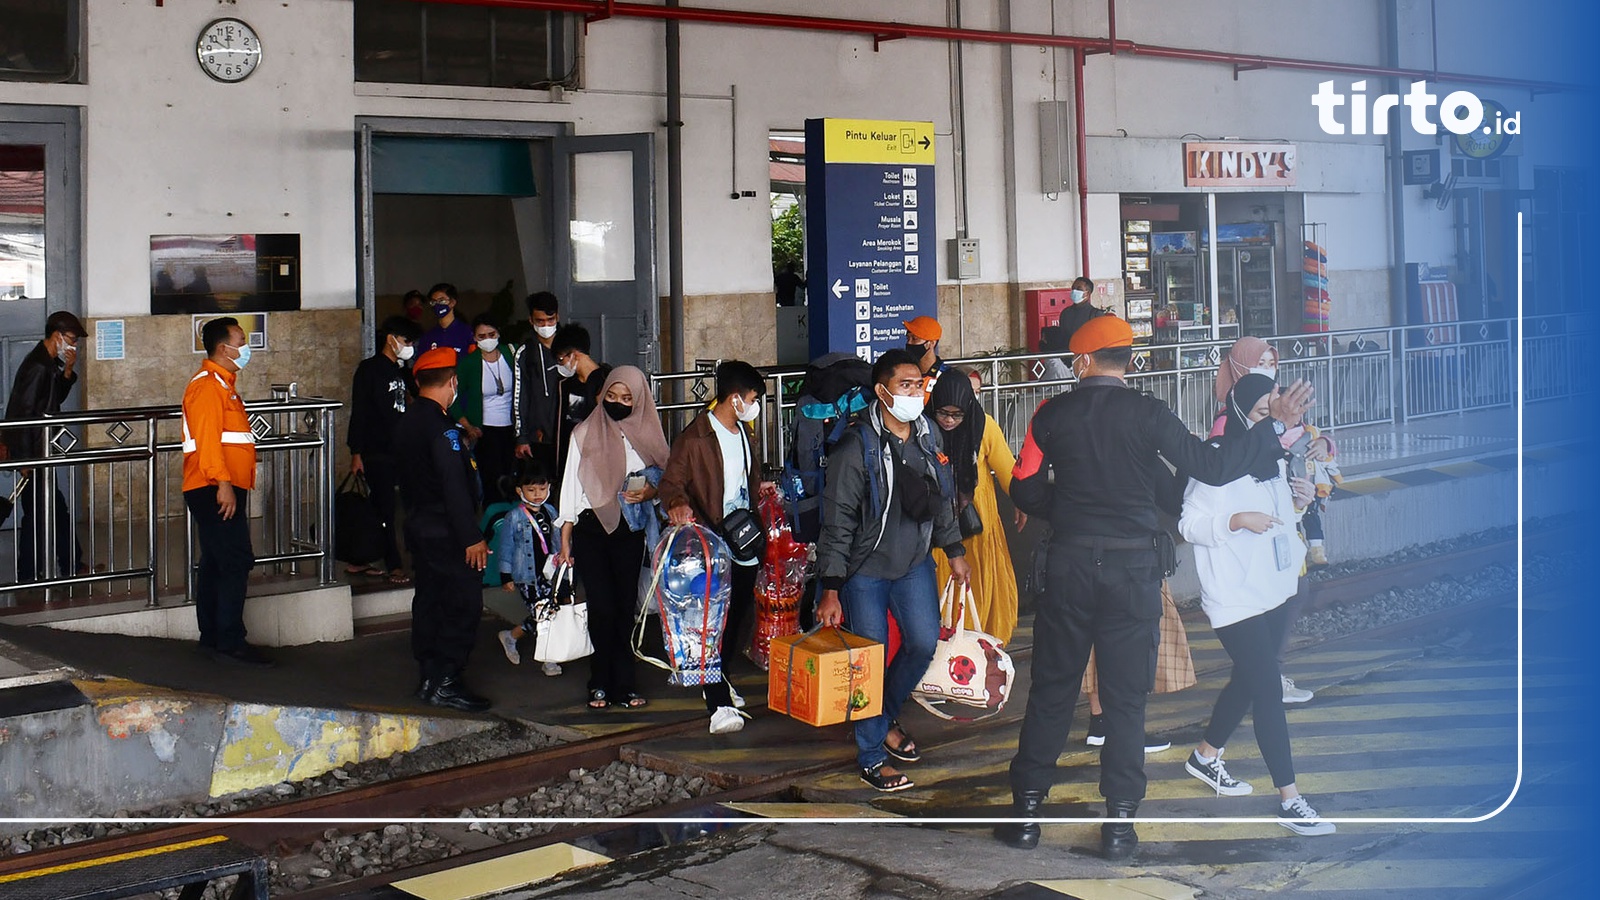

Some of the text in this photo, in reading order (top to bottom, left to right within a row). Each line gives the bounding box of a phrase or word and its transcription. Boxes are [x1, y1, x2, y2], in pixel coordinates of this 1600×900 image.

[216, 28, 223, 36] 11
[238, 30, 242, 38] 1
[244, 37, 250, 46] 2
[208, 56, 214, 64] 8
[216, 64, 222, 72] 7
[226, 66, 232, 76] 6
[236, 64, 242, 73] 5
[846, 130, 897, 141] Pintu Keluar
[1189, 150, 1295, 179] KINDY'S
[884, 172, 900, 180] Toilet
[848, 260, 902, 268] Layanan Pelanggan
